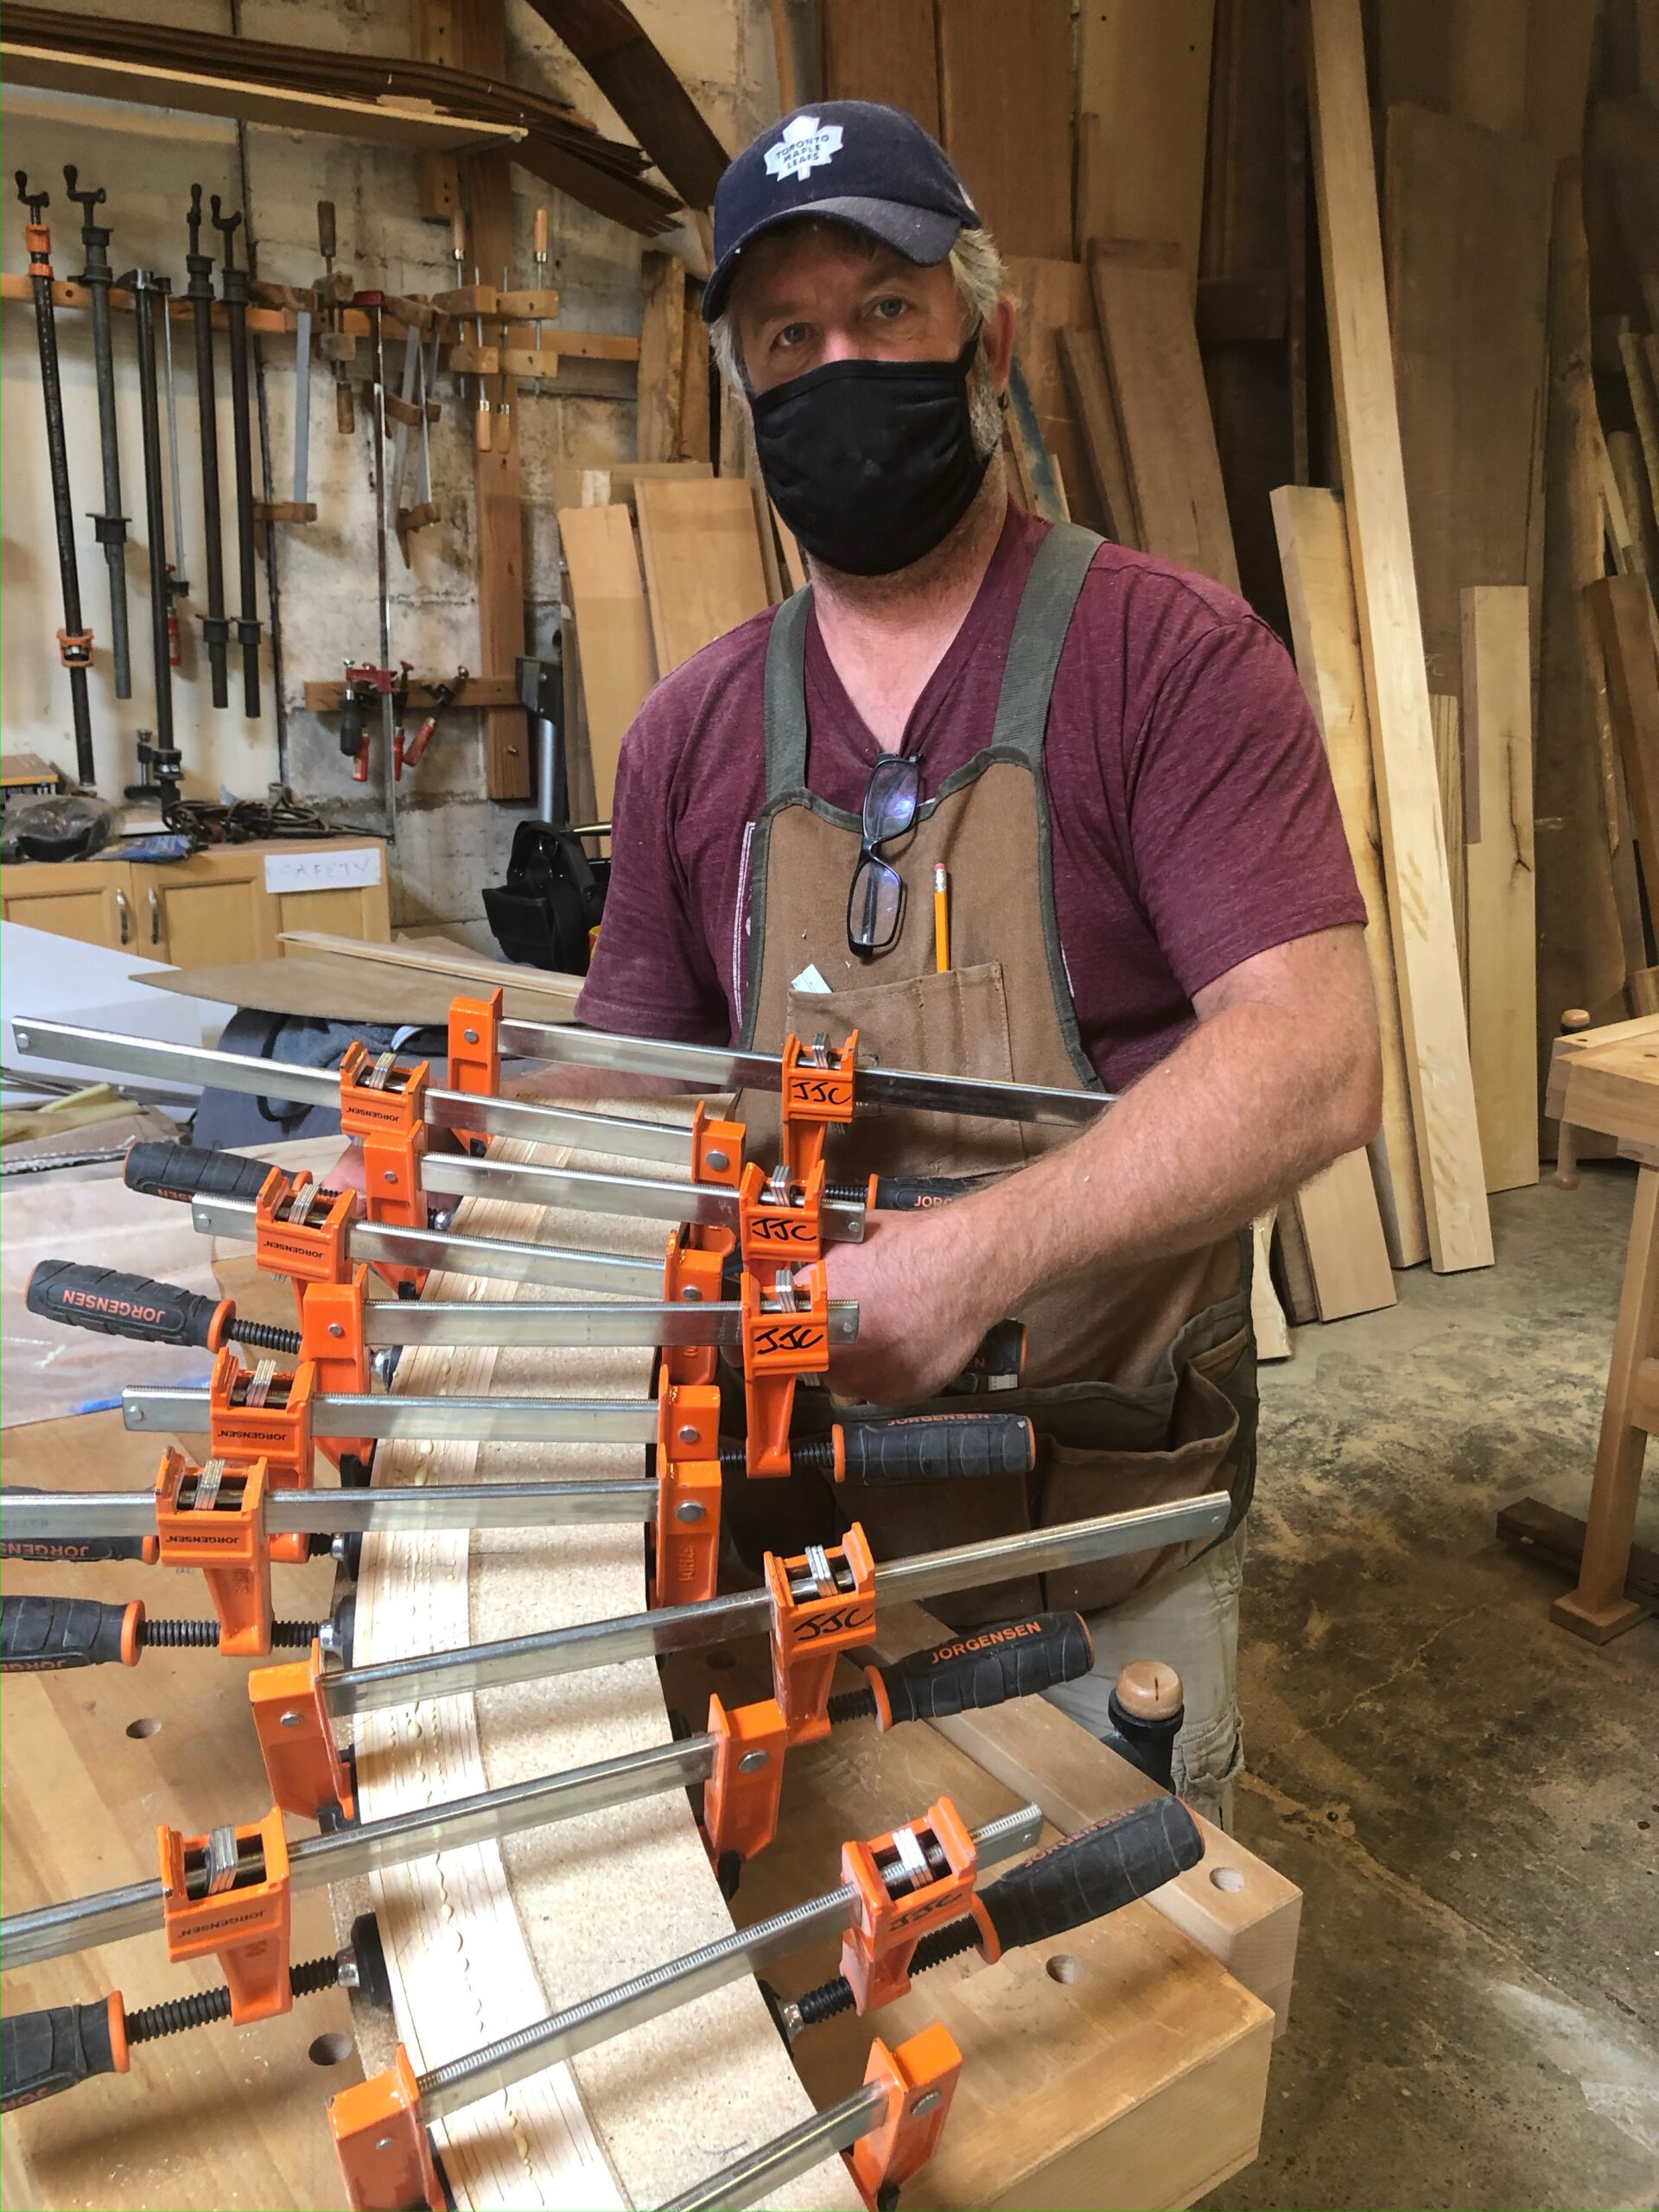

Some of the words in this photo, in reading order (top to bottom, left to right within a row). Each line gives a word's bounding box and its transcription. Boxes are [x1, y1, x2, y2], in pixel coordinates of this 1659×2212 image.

[776, 135, 830, 159] TORONTO
[784, 144, 820, 162] MAPLE
[787, 153, 819, 169] LEAFS
[791, 1082, 851, 1105] JJC
[347, 1107, 399, 1122] JORGENSEN
[752, 1217, 817, 1241] JJC
[265, 1241, 323, 1258] JORGENSEN
[63, 1289, 166, 1324] JORGENSEN
[754, 1325, 823, 1354] JJC
[219, 1430, 287, 1440] JORGENSEN
[793, 1608, 874, 1641] JJC
[931, 1622, 1041, 1664] JORGENSEN
[179, 1910, 266, 1937] JORGENSEN
